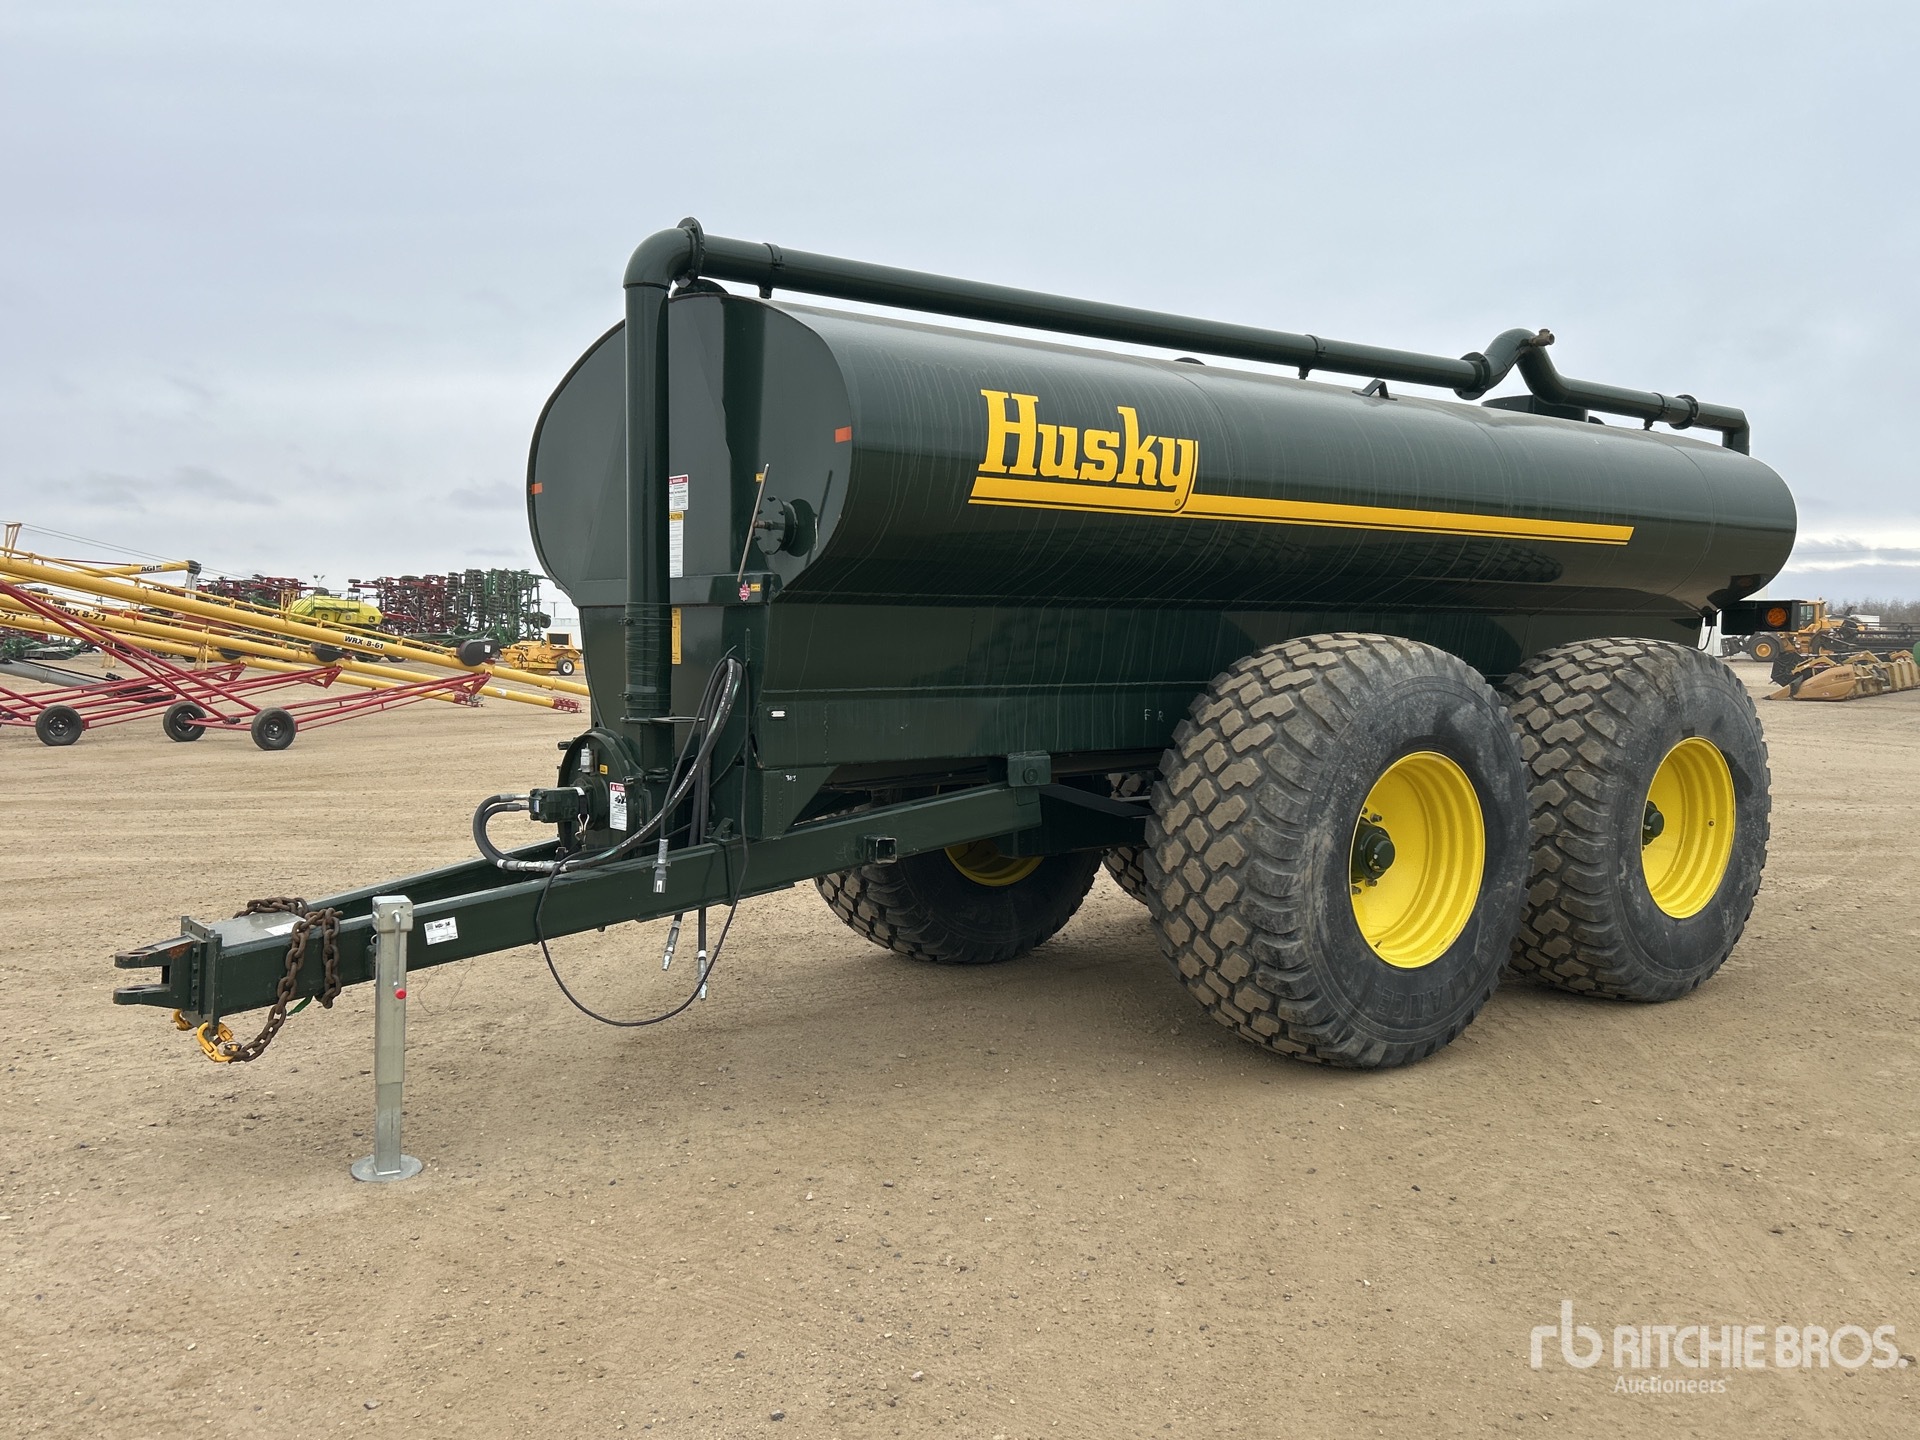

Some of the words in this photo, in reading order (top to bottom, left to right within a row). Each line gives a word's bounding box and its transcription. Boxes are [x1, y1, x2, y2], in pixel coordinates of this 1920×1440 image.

[977, 388, 1198, 508] Husky
[141, 565, 155, 573] AGI
[82, 610, 107, 621] 8-71
[344, 635, 363, 645] WRX
[366, 640, 384, 650] 8-61
